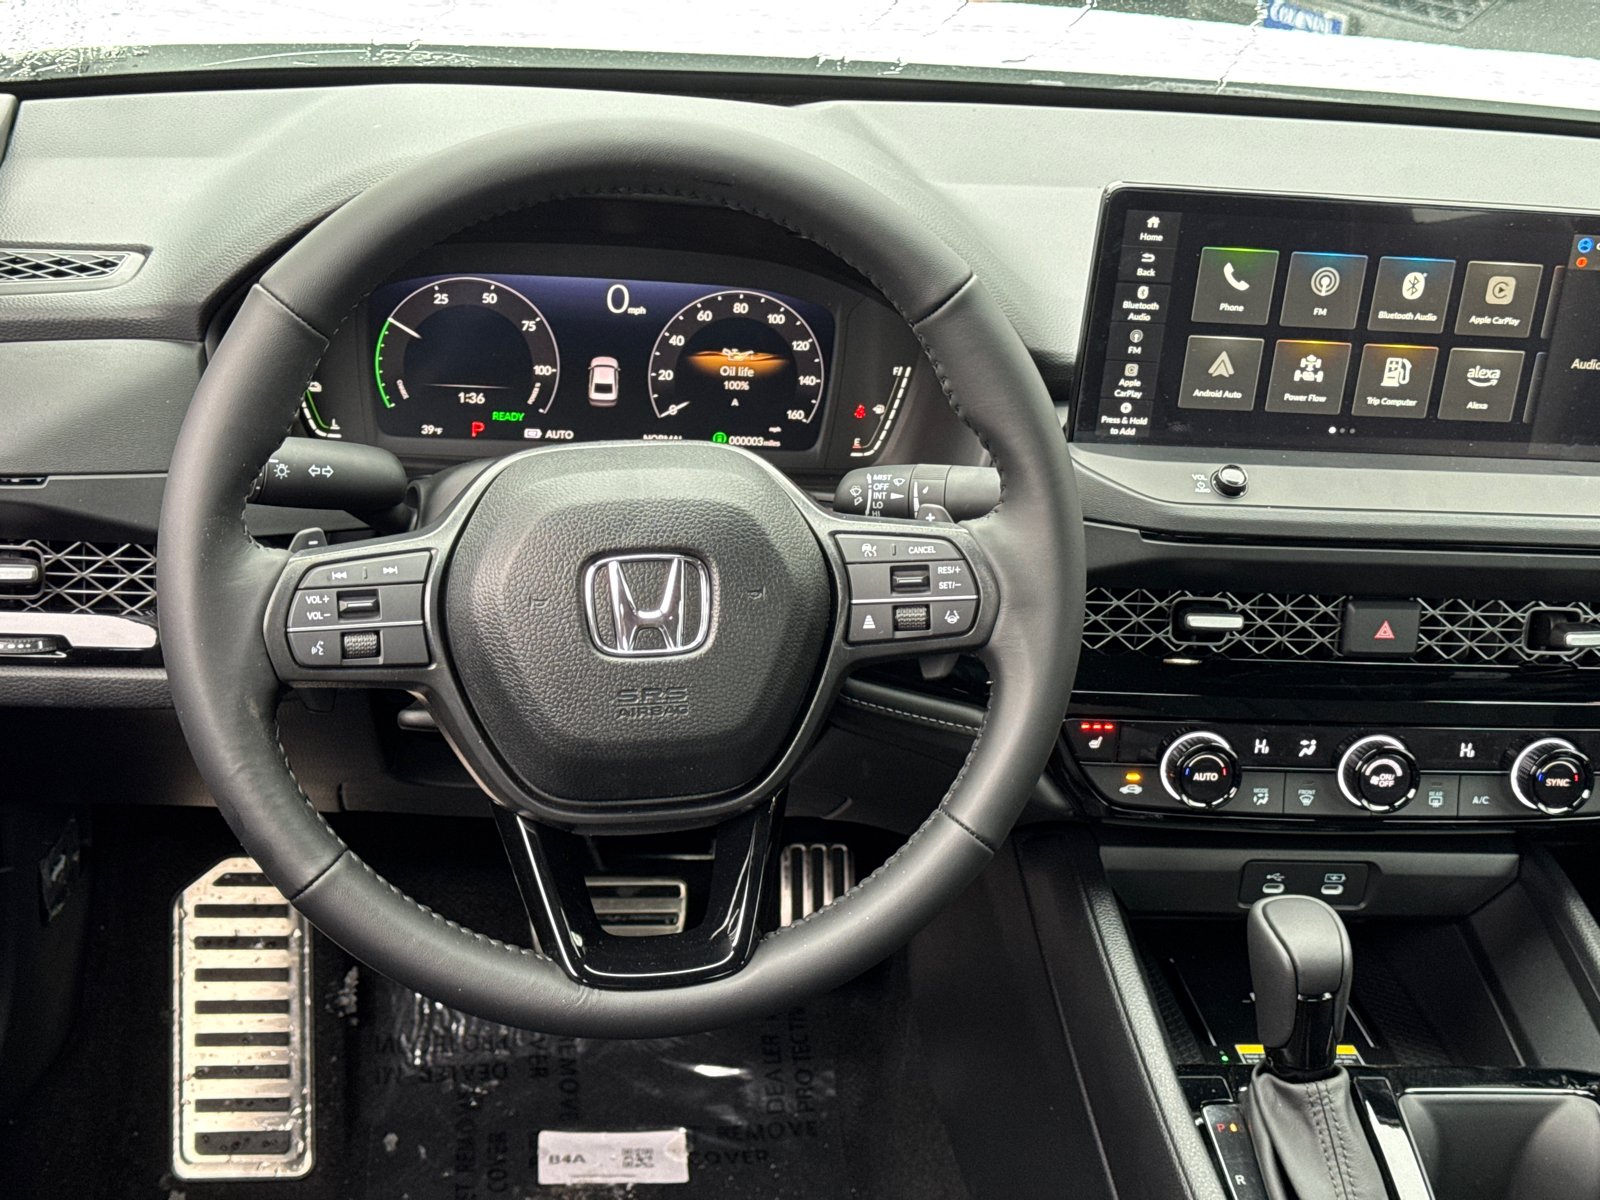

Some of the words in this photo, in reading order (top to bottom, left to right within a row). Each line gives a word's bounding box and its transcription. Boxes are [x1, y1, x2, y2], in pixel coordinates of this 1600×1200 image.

[1140, 232, 1163, 242] Home
[1137, 268, 1156, 277] Back
[434, 294, 449, 304] 25
[482, 293, 498, 304] 50
[606, 284, 629, 313] 0
[628, 305, 646, 316] mph
[733, 302, 748, 314] 80
[1122, 301, 1160, 310] Bluetooth
[1220, 303, 1244, 312] Phone
[697, 310, 712, 322] 60
[1128, 312, 1151, 322] Audio
[1313, 308, 1328, 316] FM
[1378, 310, 1413, 320] Bluetooth
[1414, 312, 1438, 322] Audio
[767, 313, 786, 325] 100
[1469, 316, 1492, 325] Apple
[1492, 316, 1521, 326] CarPlay
[521, 320, 536, 332] 75
[669, 335, 685, 346] 40
[792, 340, 810, 352] 120
[1128, 346, 1142, 354] FM
[534, 366, 552, 376] 100
[658, 370, 674, 381] 20
[720, 366, 736, 378] Oil
[737, 366, 754, 378] life
[1467, 365, 1501, 380] alexa
[724, 381, 750, 391] 100%
[798, 376, 816, 386] 140
[1118, 378, 1142, 388] Apple
[458, 392, 486, 404] 1:36
[1114, 390, 1142, 400] CarPlay
[1193, 389, 1222, 398] Android
[1223, 390, 1242, 399] Auto
[1284, 394, 1308, 402] Power
[1308, 394, 1327, 402] Flow
[731, 398, 740, 407] A
[1366, 397, 1380, 407] Trip
[1381, 398, 1418, 407] Computer
[1466, 402, 1488, 410] Alexa
[492, 412, 525, 422] READY
[786, 410, 804, 420] 160
[1101, 416, 1120, 424] Press
[1122, 416, 1128, 425] &
[1130, 417, 1148, 426] Hold
[472, 422, 485, 437] P
[1120, 427, 1136, 436] Add
[545, 430, 574, 440] AUTO
[728, 436, 764, 446] 000003
[873, 483, 890, 491] OFF
[873, 492, 888, 500] INT
[872, 501, 884, 510] LO
[908, 546, 936, 554] CANCEL
[617, 688, 688, 703] SRS
[616, 705, 689, 718] AIRBAG
[1192, 772, 1218, 782] AUTO
[1546, 778, 1571, 788] SYNC
[1472, 796, 1490, 805] A/C
[788, 1005, 815, 1114] PROTECTI
[1216, 1123, 1226, 1133] P
[550, 1154, 586, 1165] B4A
[1234, 1174, 1247, 1186] R
